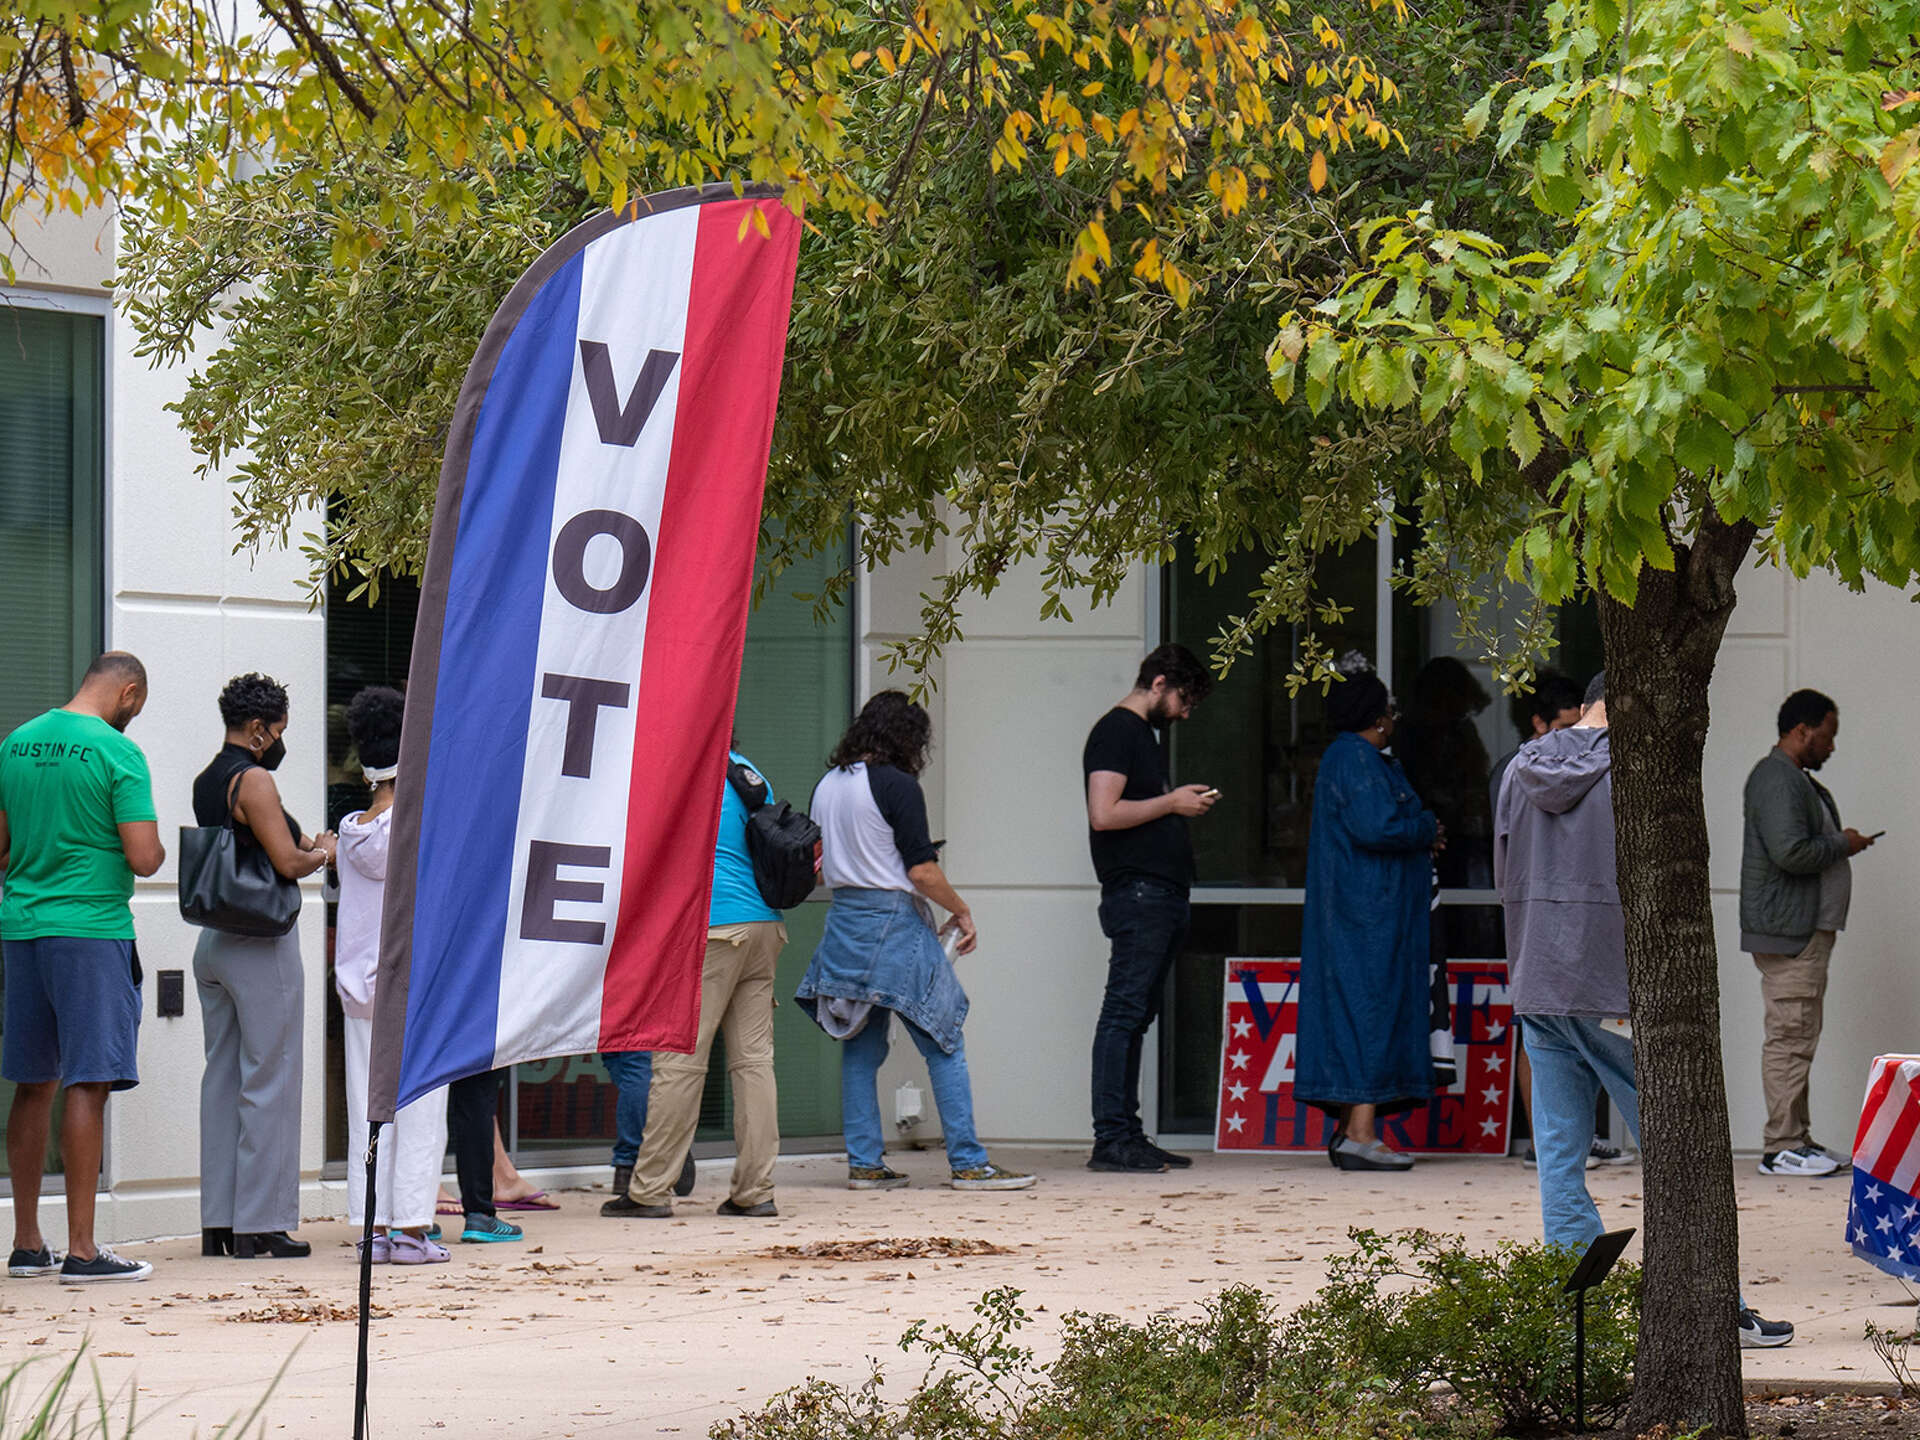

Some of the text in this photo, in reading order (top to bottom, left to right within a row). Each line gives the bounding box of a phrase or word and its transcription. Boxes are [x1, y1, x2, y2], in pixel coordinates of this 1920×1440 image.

[520, 339, 680, 945] VOTE
[10, 742, 92, 763] AUSTIN FC
[1235, 970, 1512, 1045] VE
